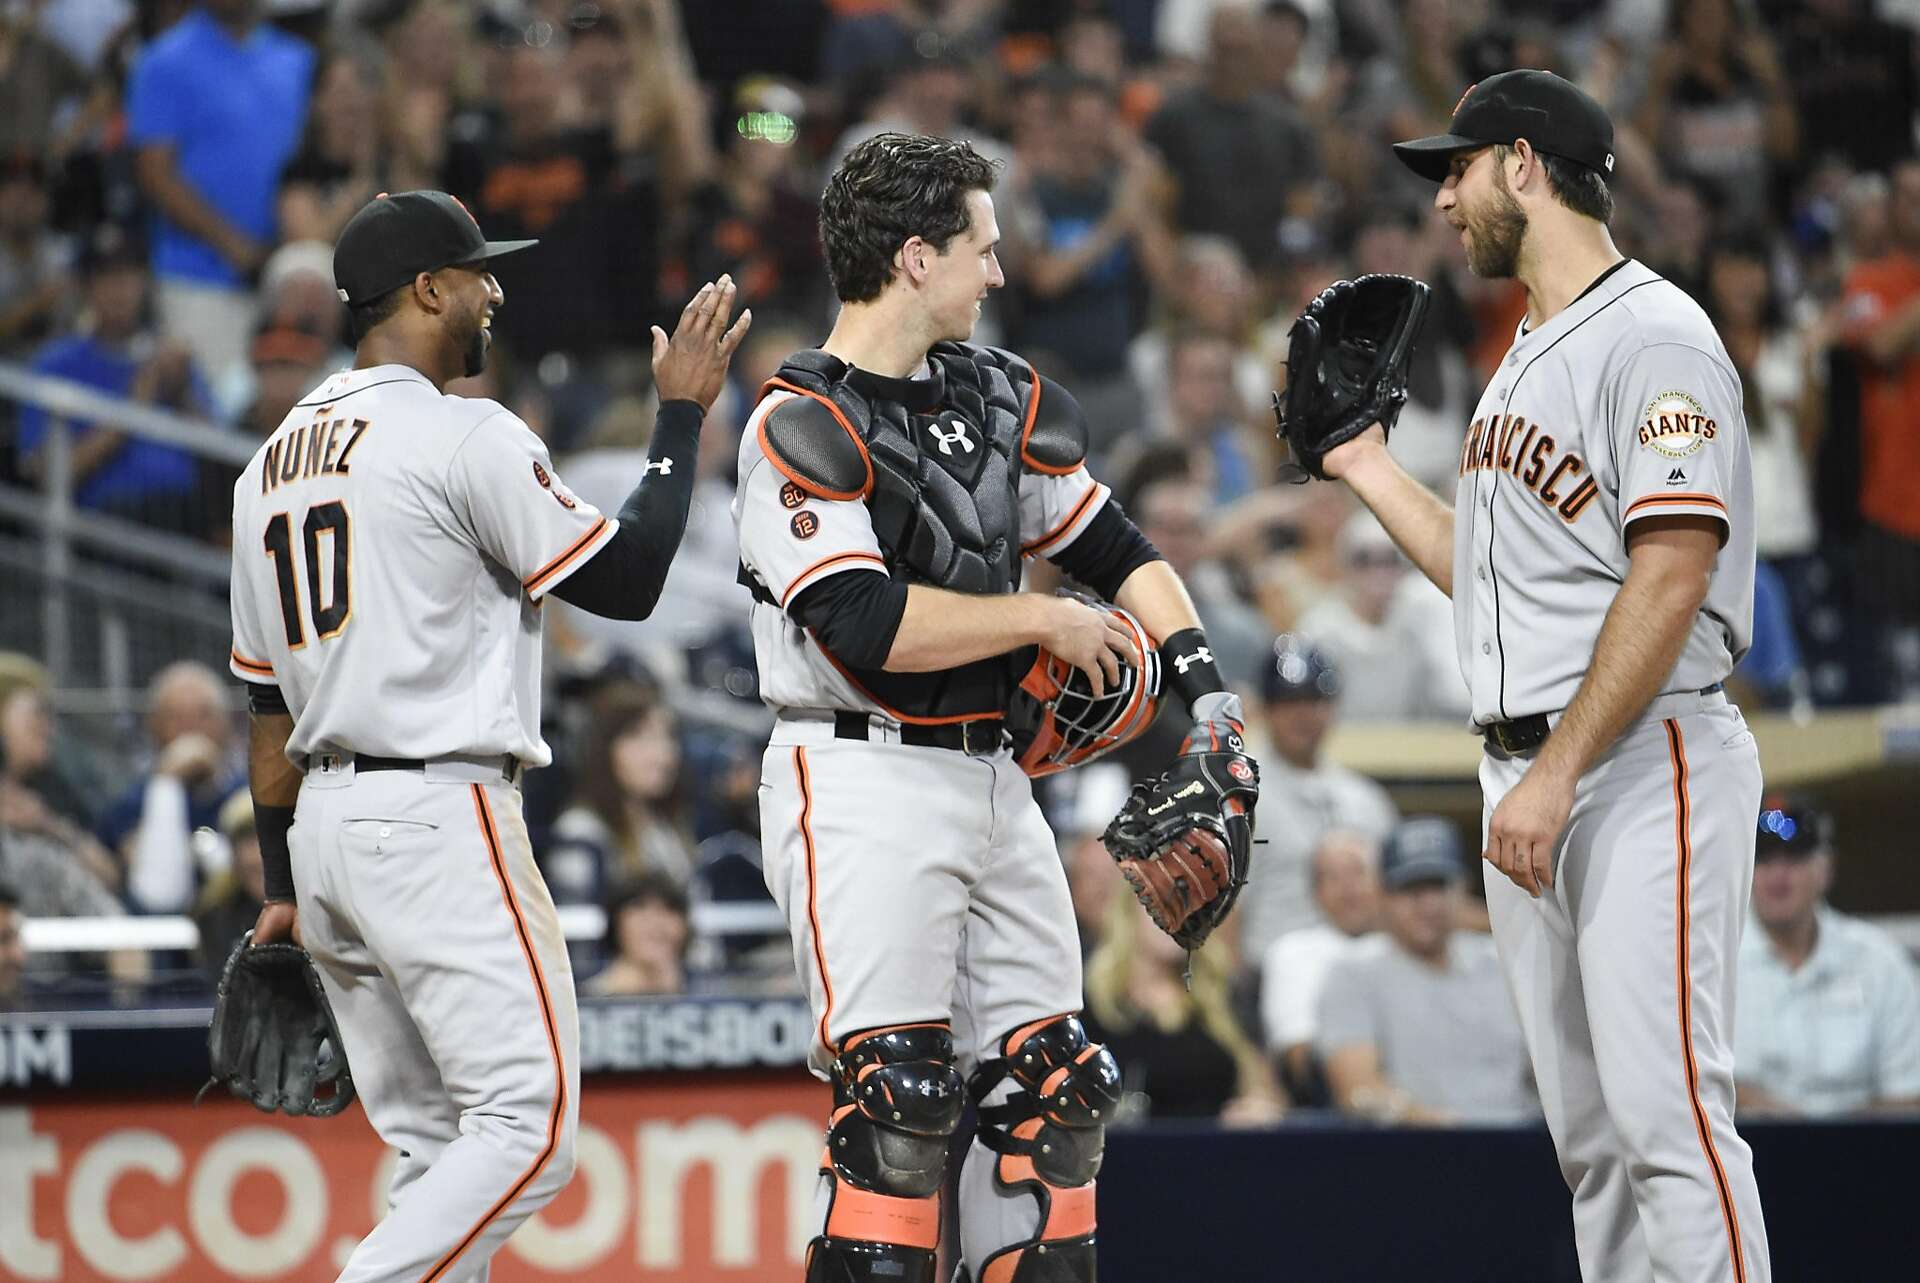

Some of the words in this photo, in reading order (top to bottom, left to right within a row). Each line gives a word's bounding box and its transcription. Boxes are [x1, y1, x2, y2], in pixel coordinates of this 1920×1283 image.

[262, 403, 371, 496] NUÑEZ
[1459, 413, 1600, 524] FRACISCO
[1638, 413, 1718, 446] GIANTS
[263, 499, 353, 650] 10
[795, 519, 816, 537] 12
